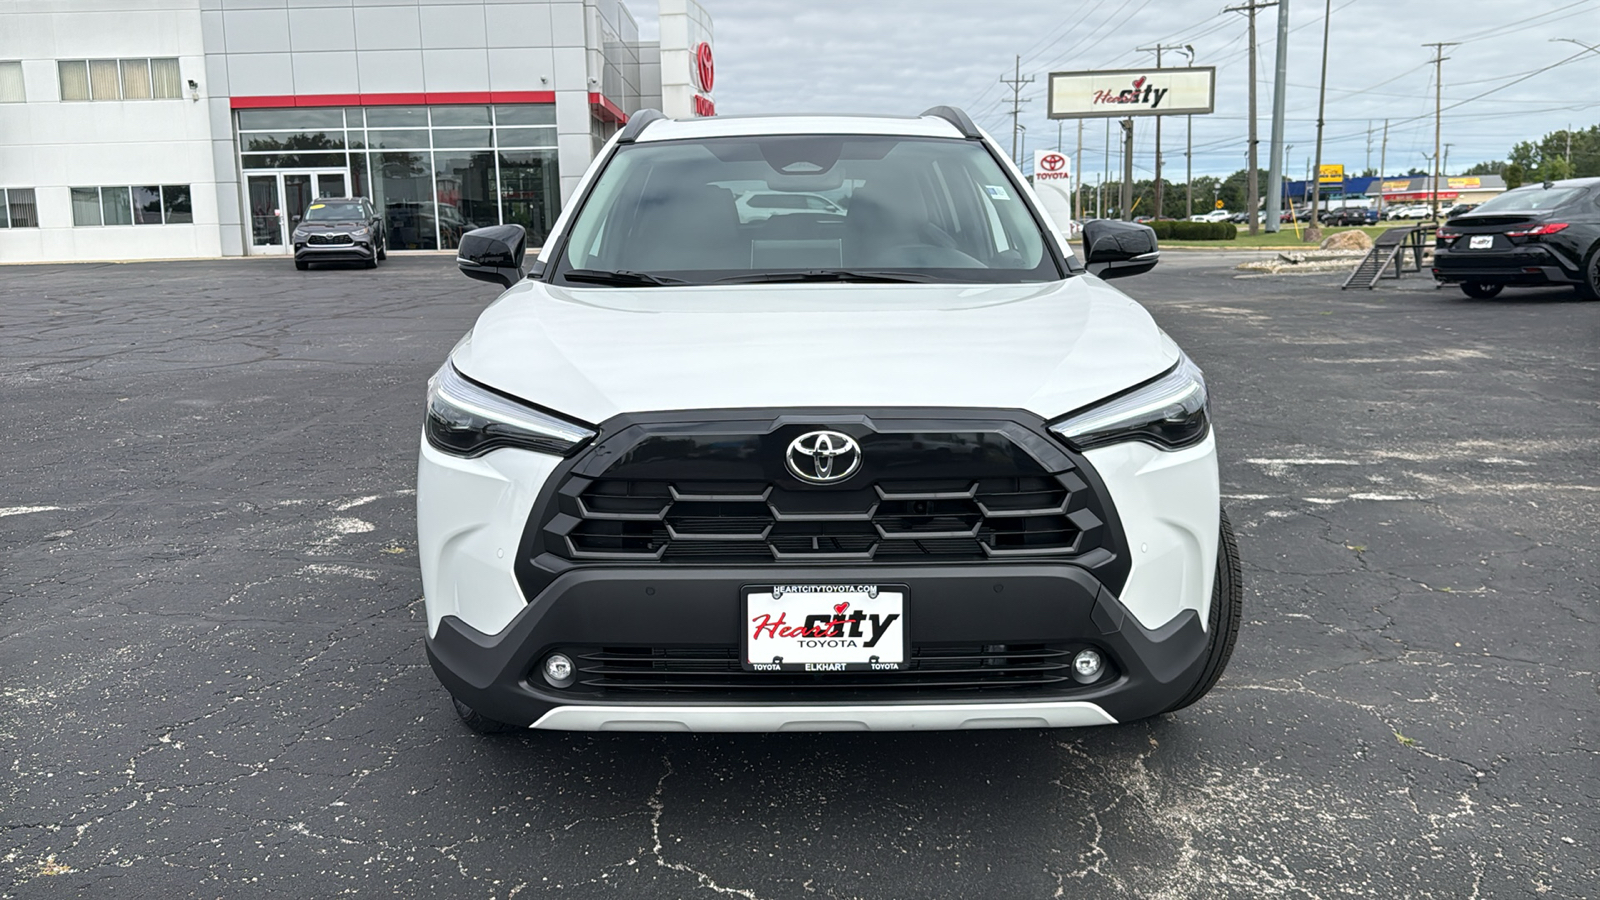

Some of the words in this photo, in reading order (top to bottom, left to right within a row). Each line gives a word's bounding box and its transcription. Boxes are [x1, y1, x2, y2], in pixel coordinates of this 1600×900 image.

[1093, 88, 1145, 104] Heart
[1036, 172, 1069, 180] TOYOTA
[774, 585, 878, 593] HEARTCITYTOYOTA.COM
[752, 612, 857, 640] Heart
[802, 605, 900, 648] city
[797, 640, 858, 648] TOYOTA
[753, 663, 781, 671] TOYOTA
[805, 663, 847, 671] ELKHART
